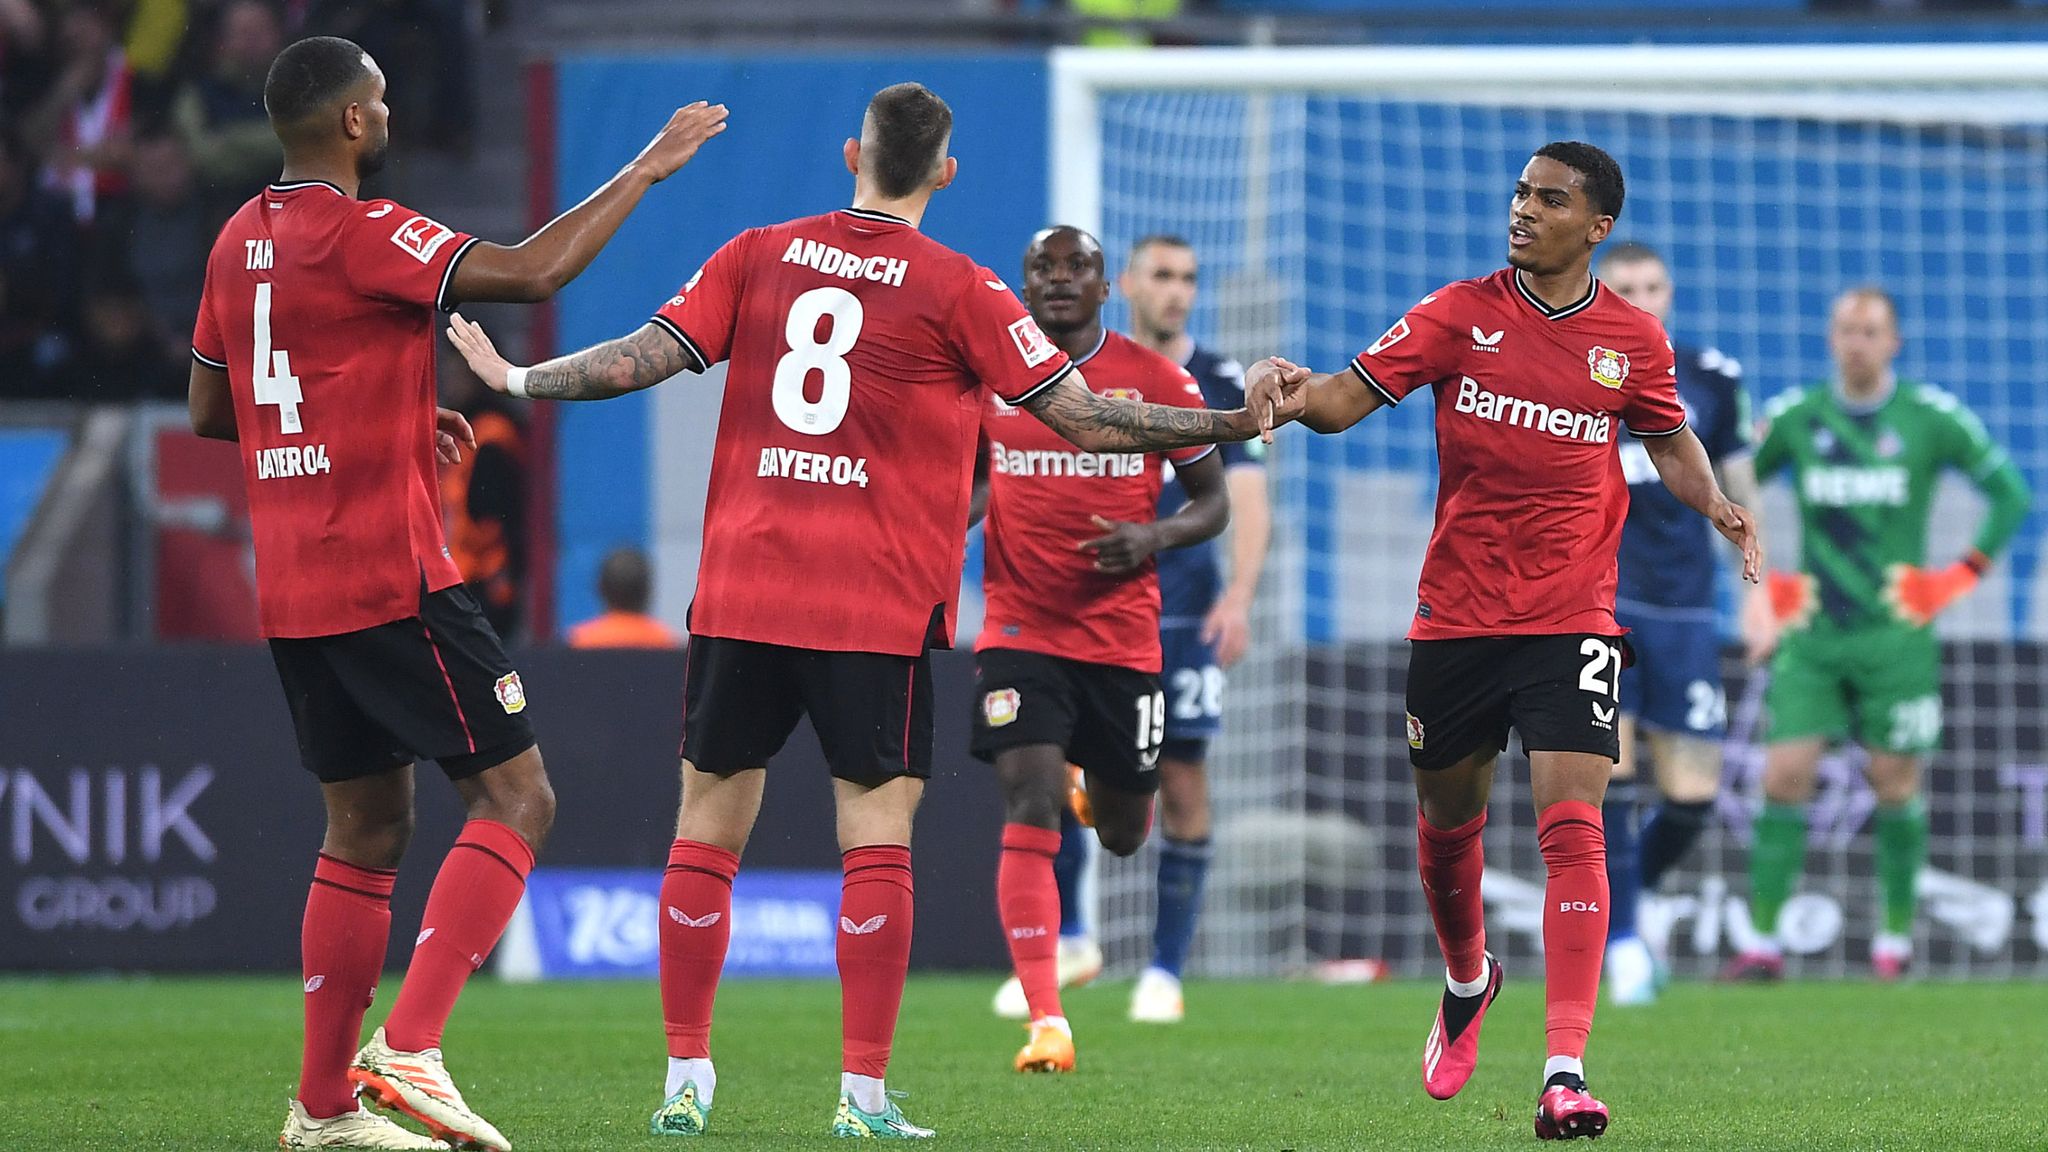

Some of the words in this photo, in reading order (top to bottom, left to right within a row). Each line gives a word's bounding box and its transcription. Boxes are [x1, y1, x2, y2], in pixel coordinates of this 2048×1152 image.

[245, 239, 274, 270] TAH
[782, 238, 909, 287] ANDRICH
[253, 282, 304, 434] 4
[772, 286, 864, 435] 8
[1455, 375, 1610, 444] Barmenia
[992, 441, 1145, 478] Barmenia
[1173, 665, 1225, 719] 28
[1578, 638, 1622, 703] 21
[1136, 690, 1165, 750] 19
[0, 764, 216, 864] NIK
[17, 877, 216, 930] GROUP
